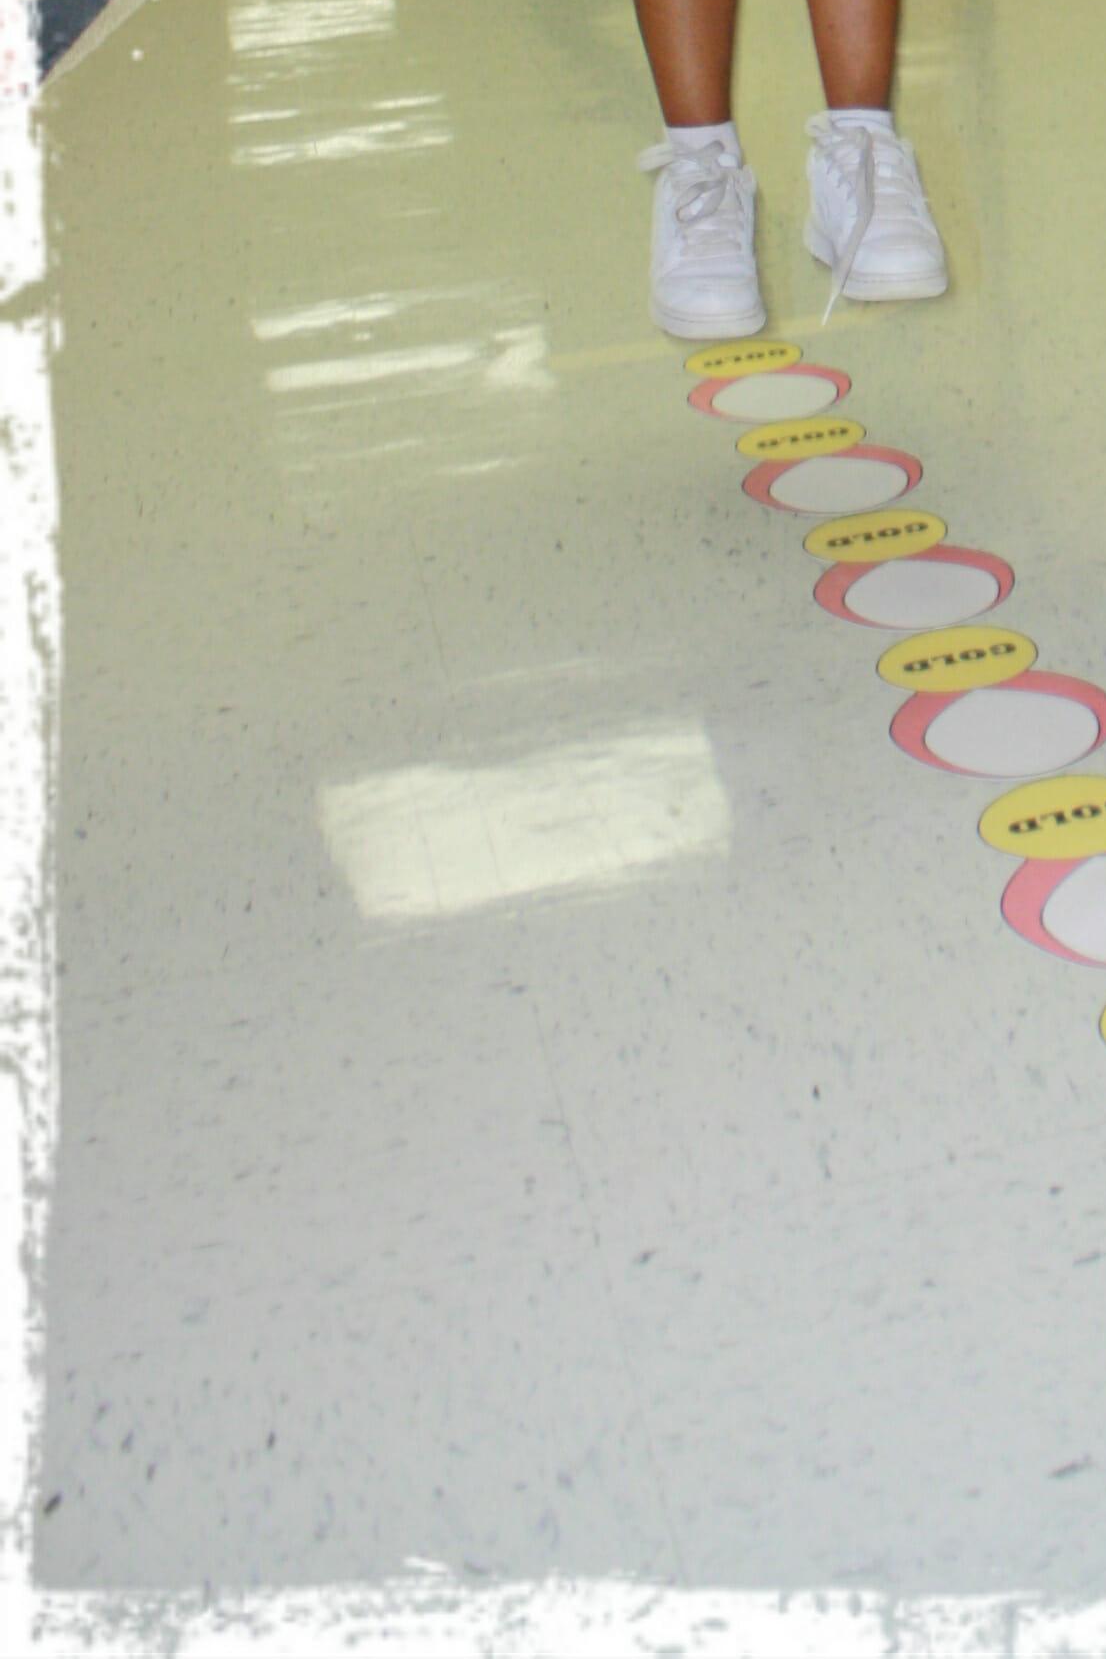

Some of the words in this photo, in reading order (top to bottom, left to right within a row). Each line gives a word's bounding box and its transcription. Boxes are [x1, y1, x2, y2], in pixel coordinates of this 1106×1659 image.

[703, 347, 789, 368] GOLD
[756, 425, 850, 450] GOLD
[826, 520, 929, 548] GOLD
[902, 641, 1018, 674] GOLD
